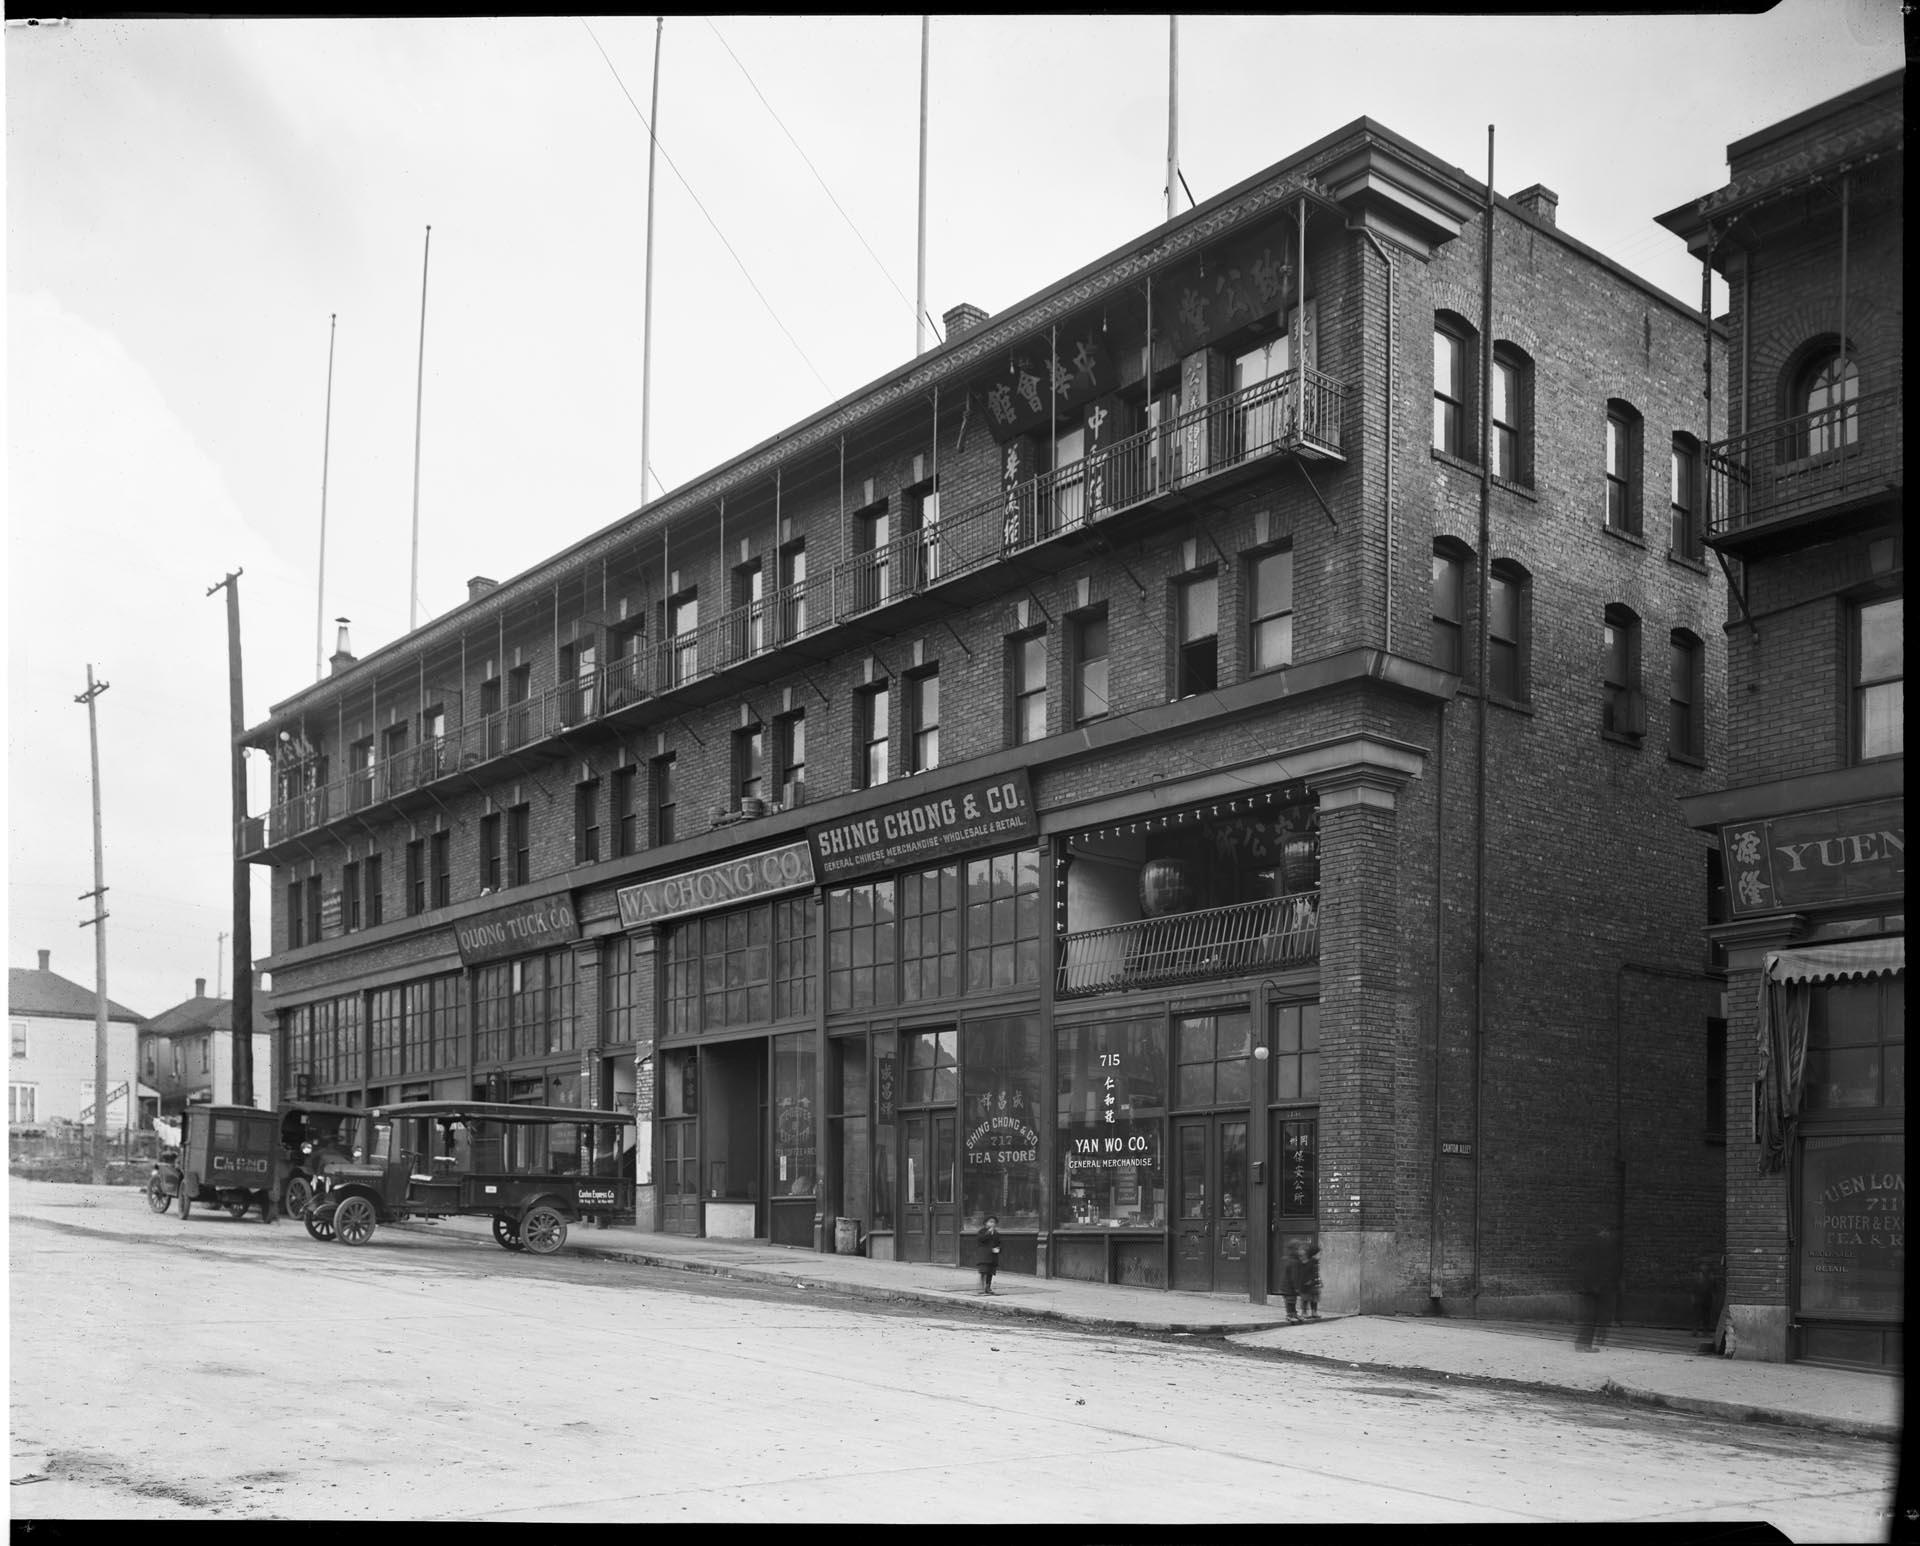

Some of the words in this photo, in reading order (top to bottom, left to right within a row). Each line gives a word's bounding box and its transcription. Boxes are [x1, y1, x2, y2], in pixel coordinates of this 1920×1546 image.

[817, 818, 879, 857] SHING
[883, 799, 957, 840] CHONG
[962, 793, 981, 820] &
[986, 783, 1026, 814] CO.
[824, 857, 855, 873] GENERAL
[855, 850, 886, 866] CHINESE
[886, 836, 938, 860] MERCHANDISE
[942, 826, 989, 845] WHOLESALE
[1775, 829, 1905, 873] YUEN
[622, 889, 658, 919] WA
[664, 863, 754, 910] CHONG
[761, 851, 808, 884] CO.
[460, 922, 506, 952] QUONG
[507, 912, 548, 940] TUCK
[550, 906, 575, 930] CO.
[1099, 1053, 1121, 1067] 715
[965, 1120, 990, 1150] SHING
[991, 1116, 1021, 1131] CHONG
[990, 1135, 1013, 1146] 717
[1075, 1138, 1099, 1153] YAN
[1104, 1137, 1123, 1153] WO
[1128, 1136, 1149, 1151] CO.
[968, 1151, 992, 1165] TEA
[997, 1149, 1036, 1163] STORE
[1069, 1159, 1101, 1169] GENERAL
[1102, 1157, 1153, 1168] MERCHANDISE
[1865, 1196, 1898, 1211] 711
[1872, 1216, 1882, 1231] &
[1884, 1216, 1904, 1231] EX
[1814, 1264, 1849, 1273] RETAIL
